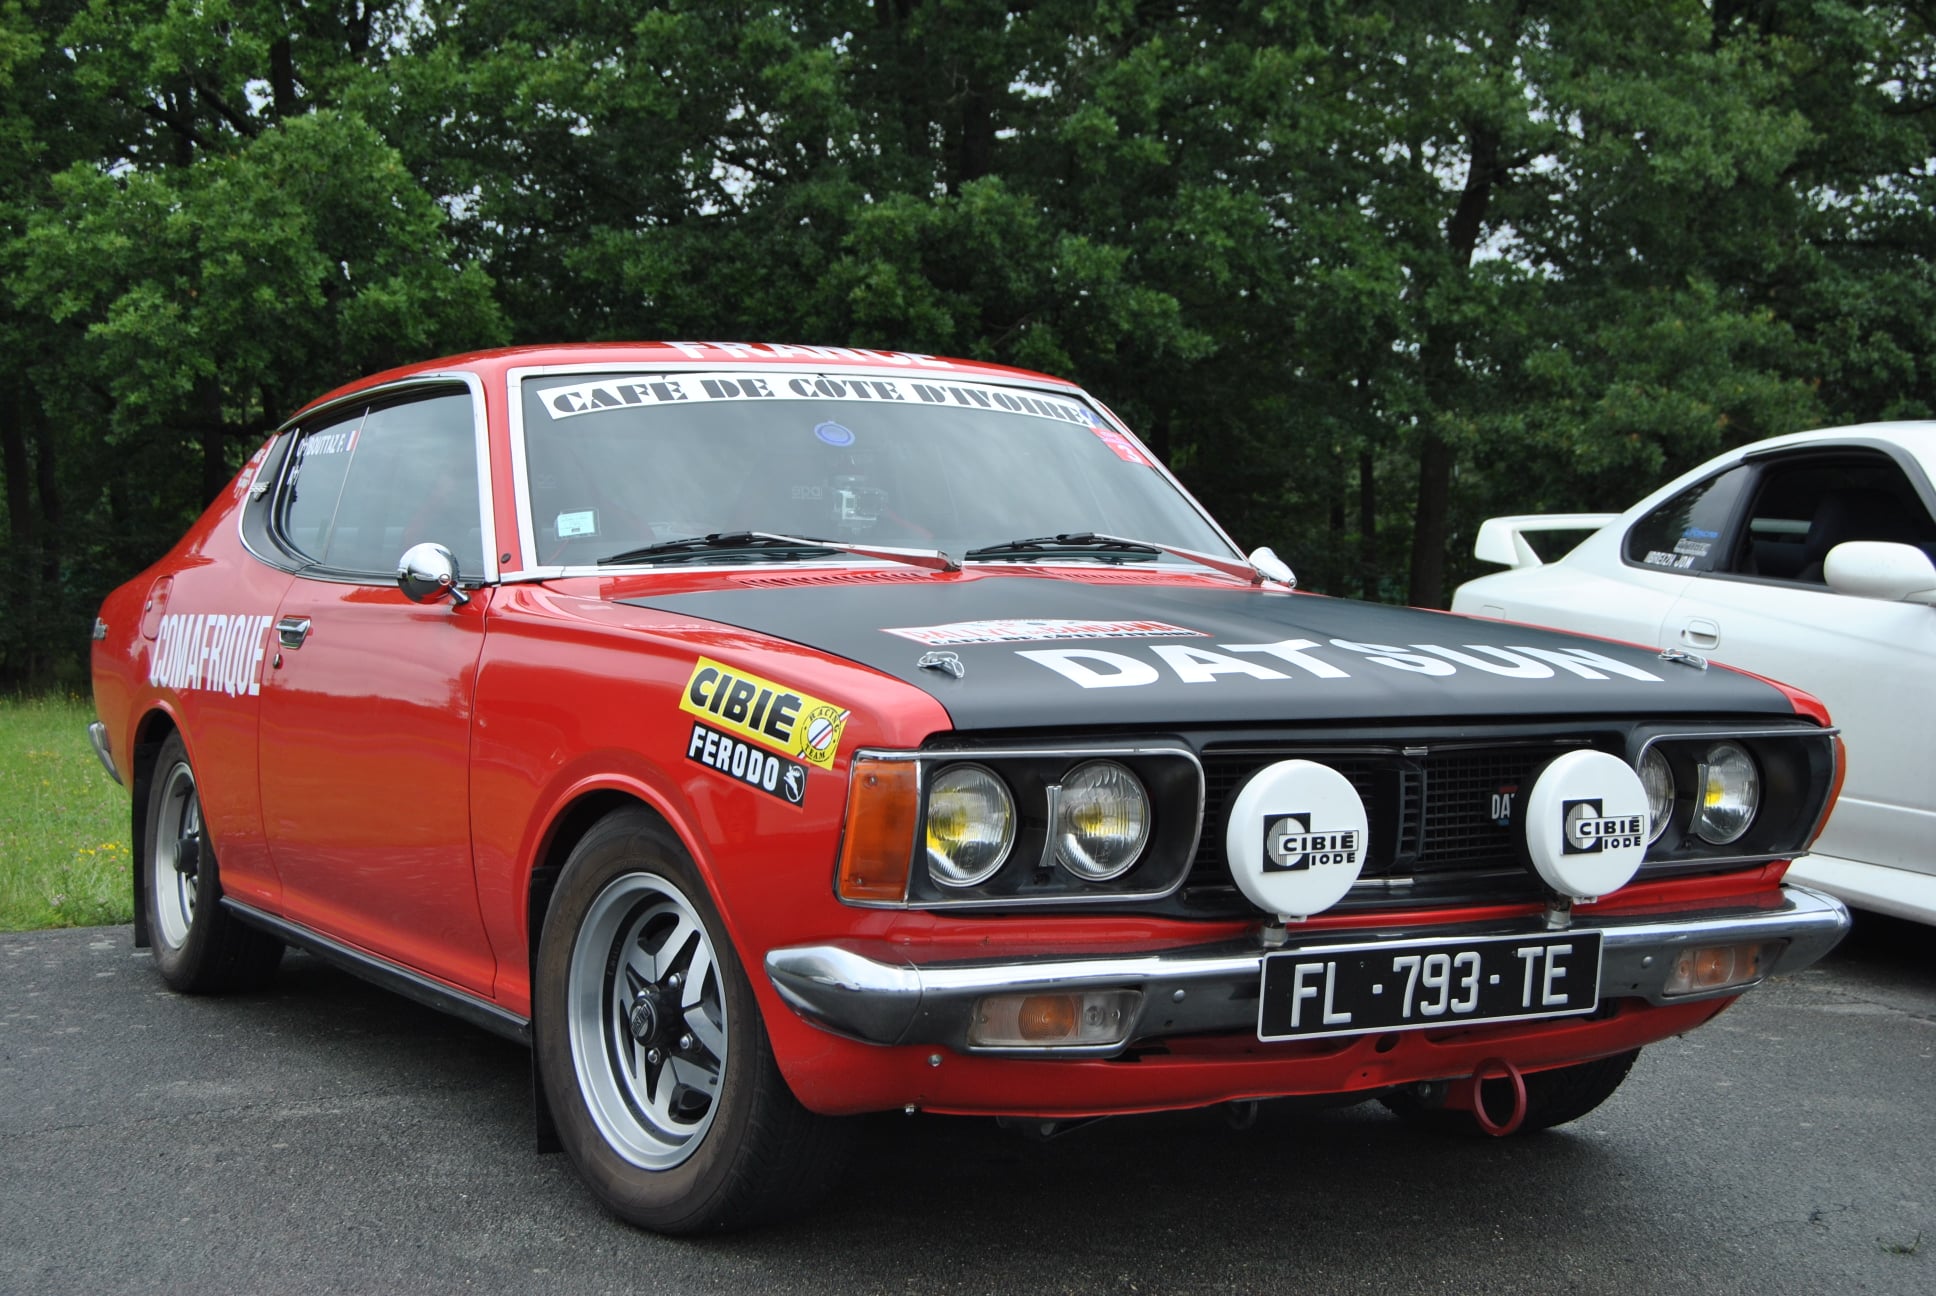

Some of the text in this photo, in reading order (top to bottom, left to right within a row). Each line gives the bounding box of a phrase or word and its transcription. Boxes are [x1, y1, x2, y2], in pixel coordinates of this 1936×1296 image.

[661, 341, 954, 368] FRANCE
[553, 372, 1091, 426] CAFÉ DE CÔTE D'IVOIRE
[149, 613, 274, 698] COMAFRIQUE
[1014, 638, 1665, 689] DATSUN
[689, 666, 804, 744] CIBIÉ
[808, 706, 841, 733] RACING
[688, 724, 780, 792] FERODO
[804, 743, 827, 760] TEAM
[1311, 852, 1356, 866] IODE
[1604, 836, 1641, 850] IODE
